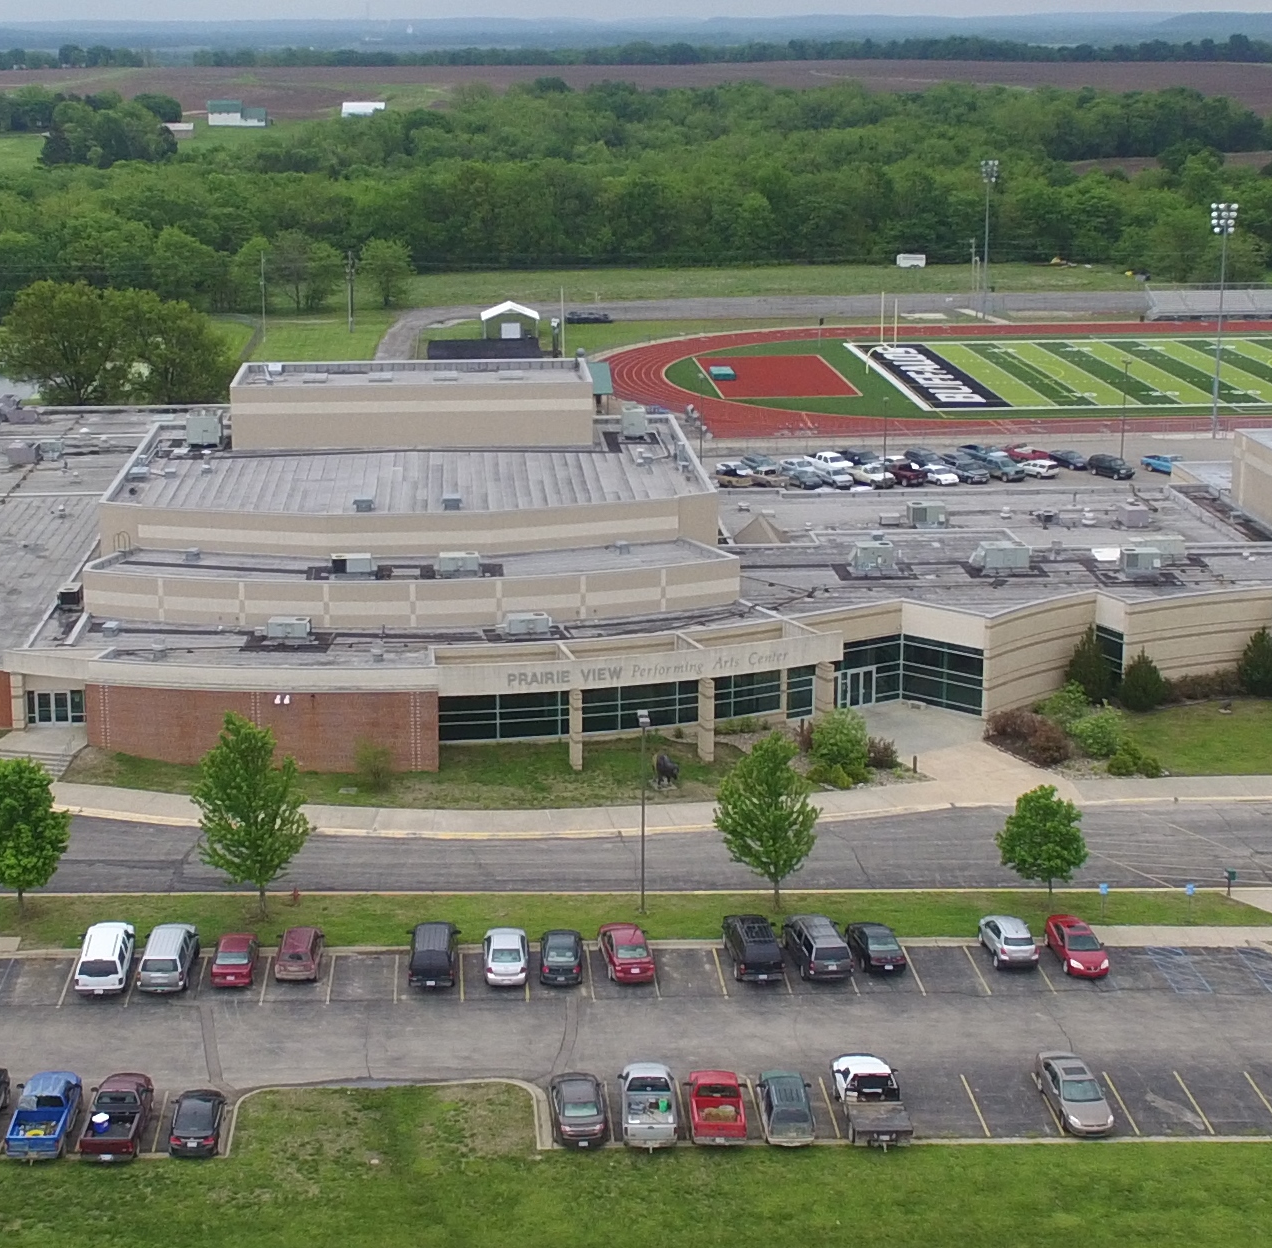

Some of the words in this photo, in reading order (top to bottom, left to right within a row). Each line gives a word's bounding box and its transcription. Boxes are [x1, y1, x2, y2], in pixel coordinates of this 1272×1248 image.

[877, 347, 986, 402] BUFFALOS
[507, 670, 571, 687] PRAIRIE
[581, 666, 623, 683] VIEW
[631, 661, 704, 678] Performing
[712, 656, 740, 670] Arts
[747, 650, 789, 666] Center
